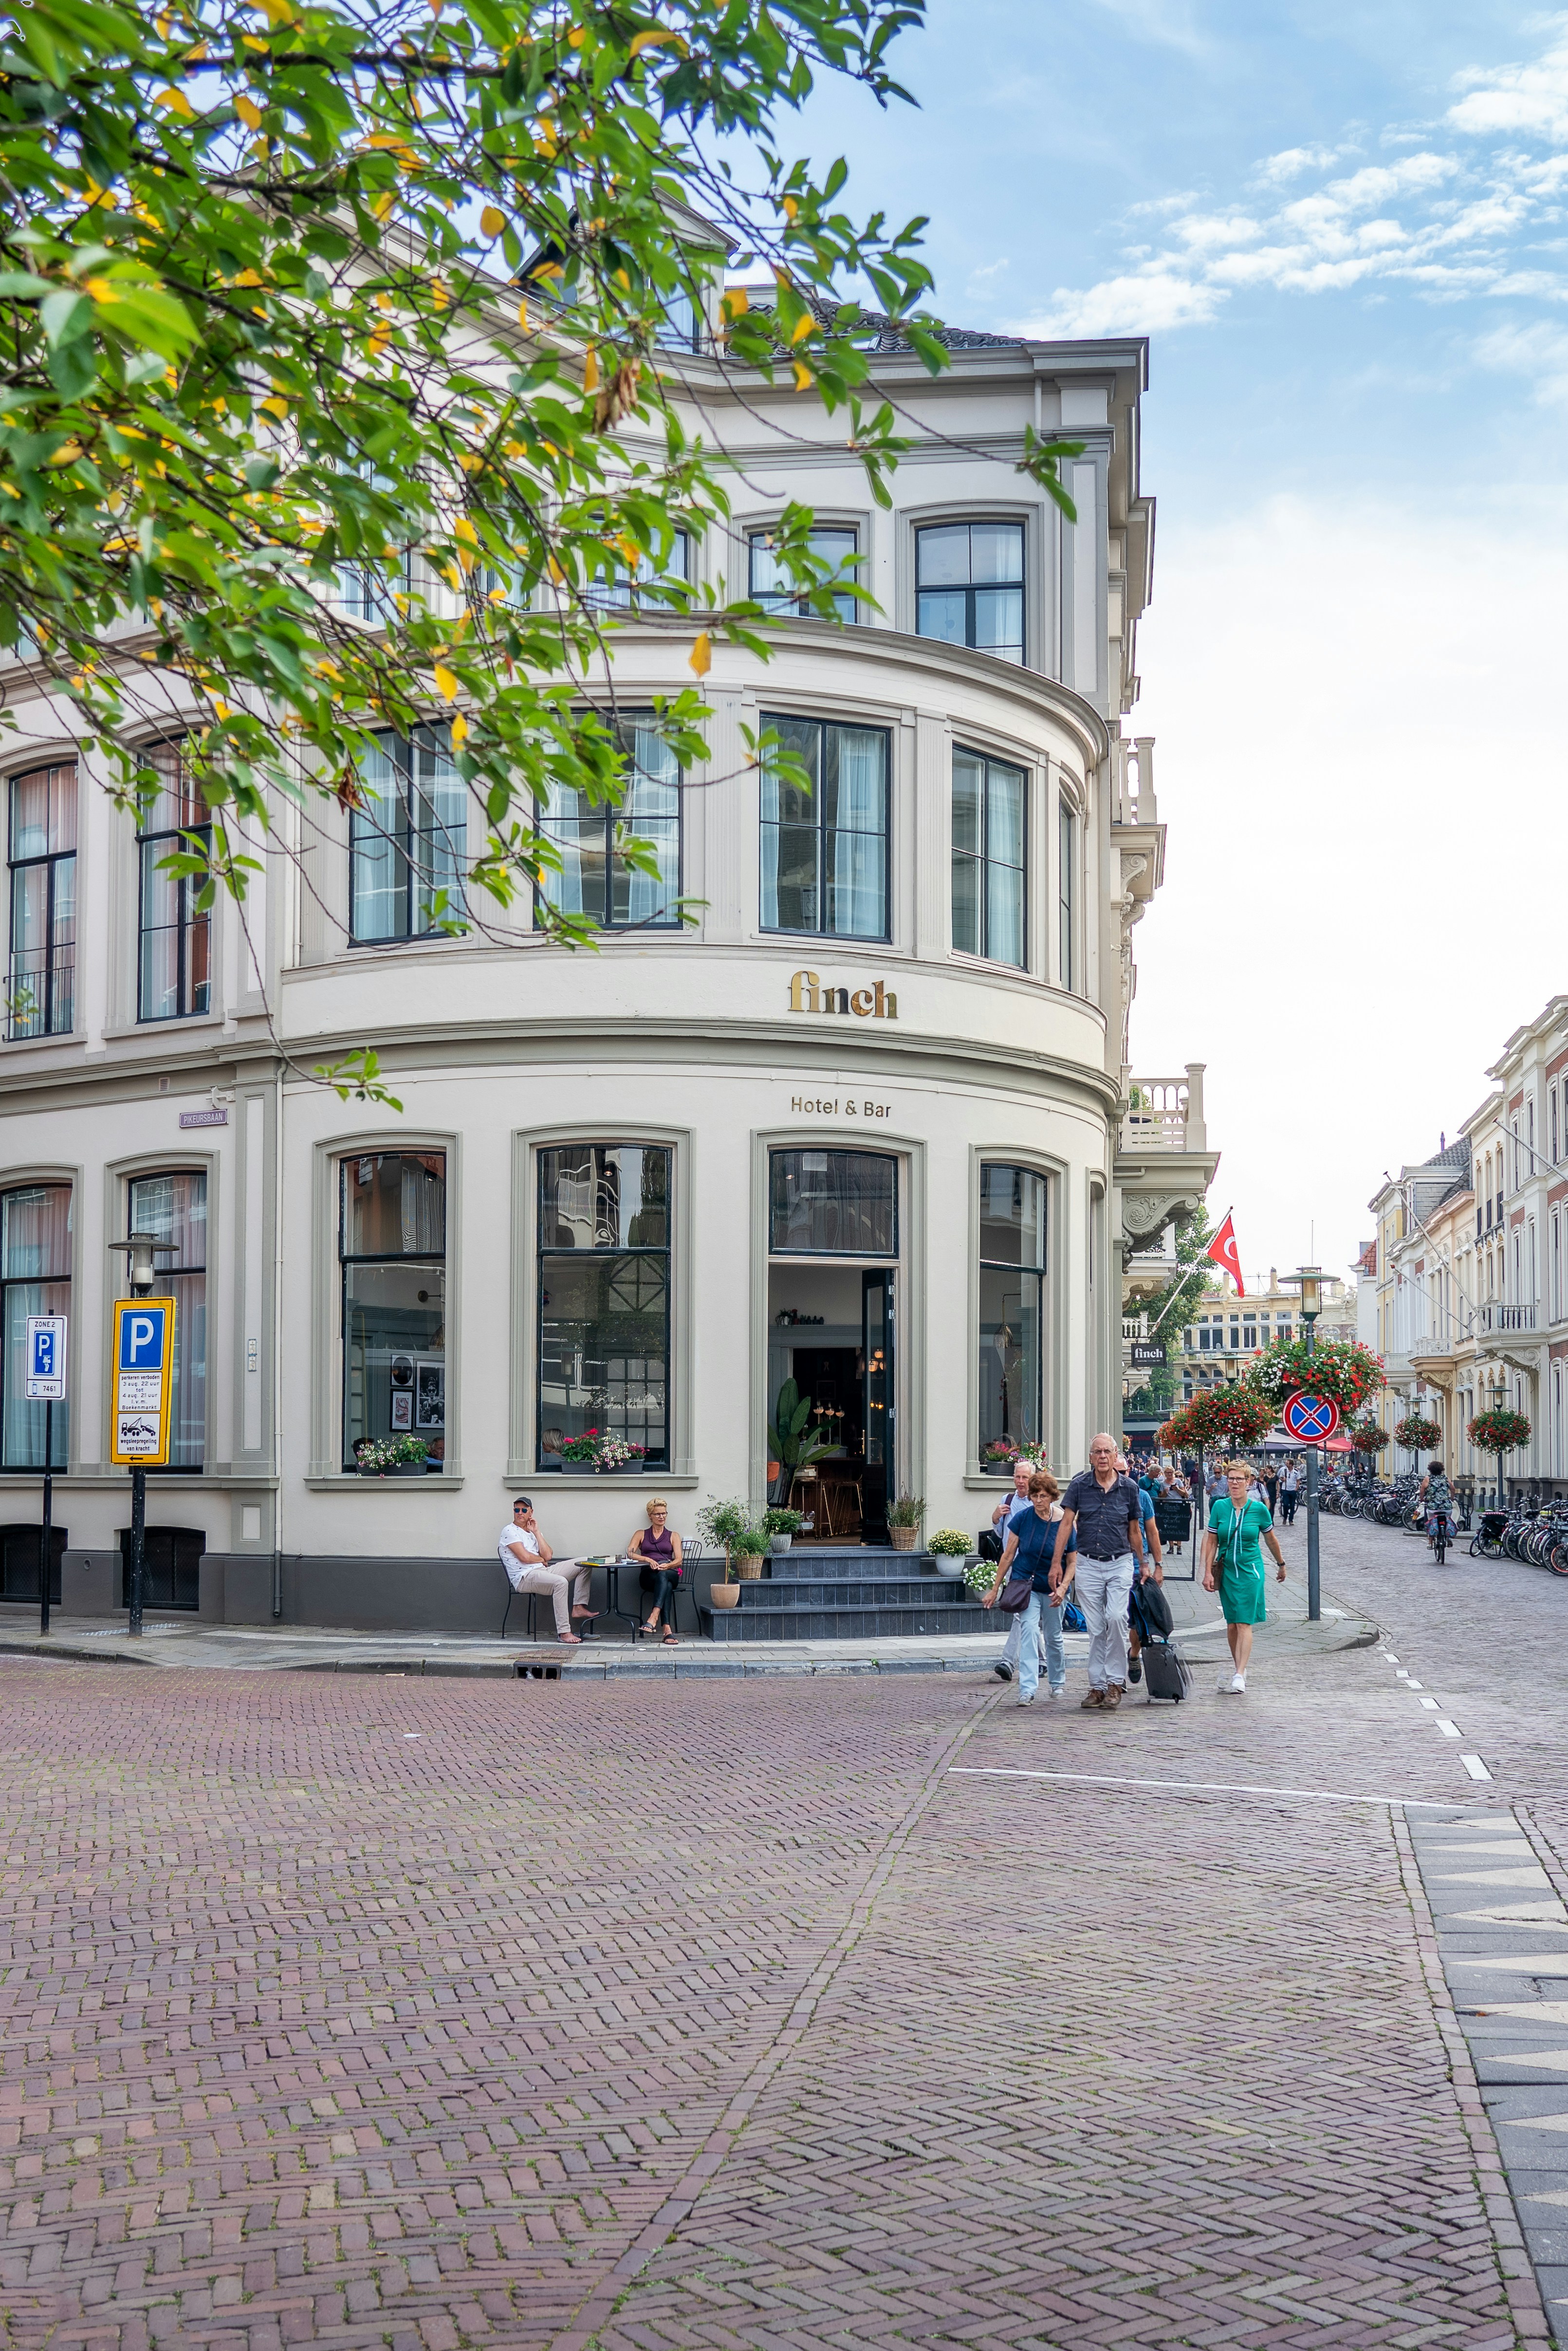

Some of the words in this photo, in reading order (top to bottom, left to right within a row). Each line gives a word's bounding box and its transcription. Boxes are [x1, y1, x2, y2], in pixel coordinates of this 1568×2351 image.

[787, 970, 900, 1019] finch
[184, 1112, 223, 1124] PIKEURSBAAN
[792, 1096, 838, 1114] Hotel
[845, 1100, 858, 1116] &
[864, 1101, 892, 1118] Bar
[38, 1335, 50, 1357] P
[130, 1317, 154, 1362] P
[1135, 1347, 1163, 1358] finch
